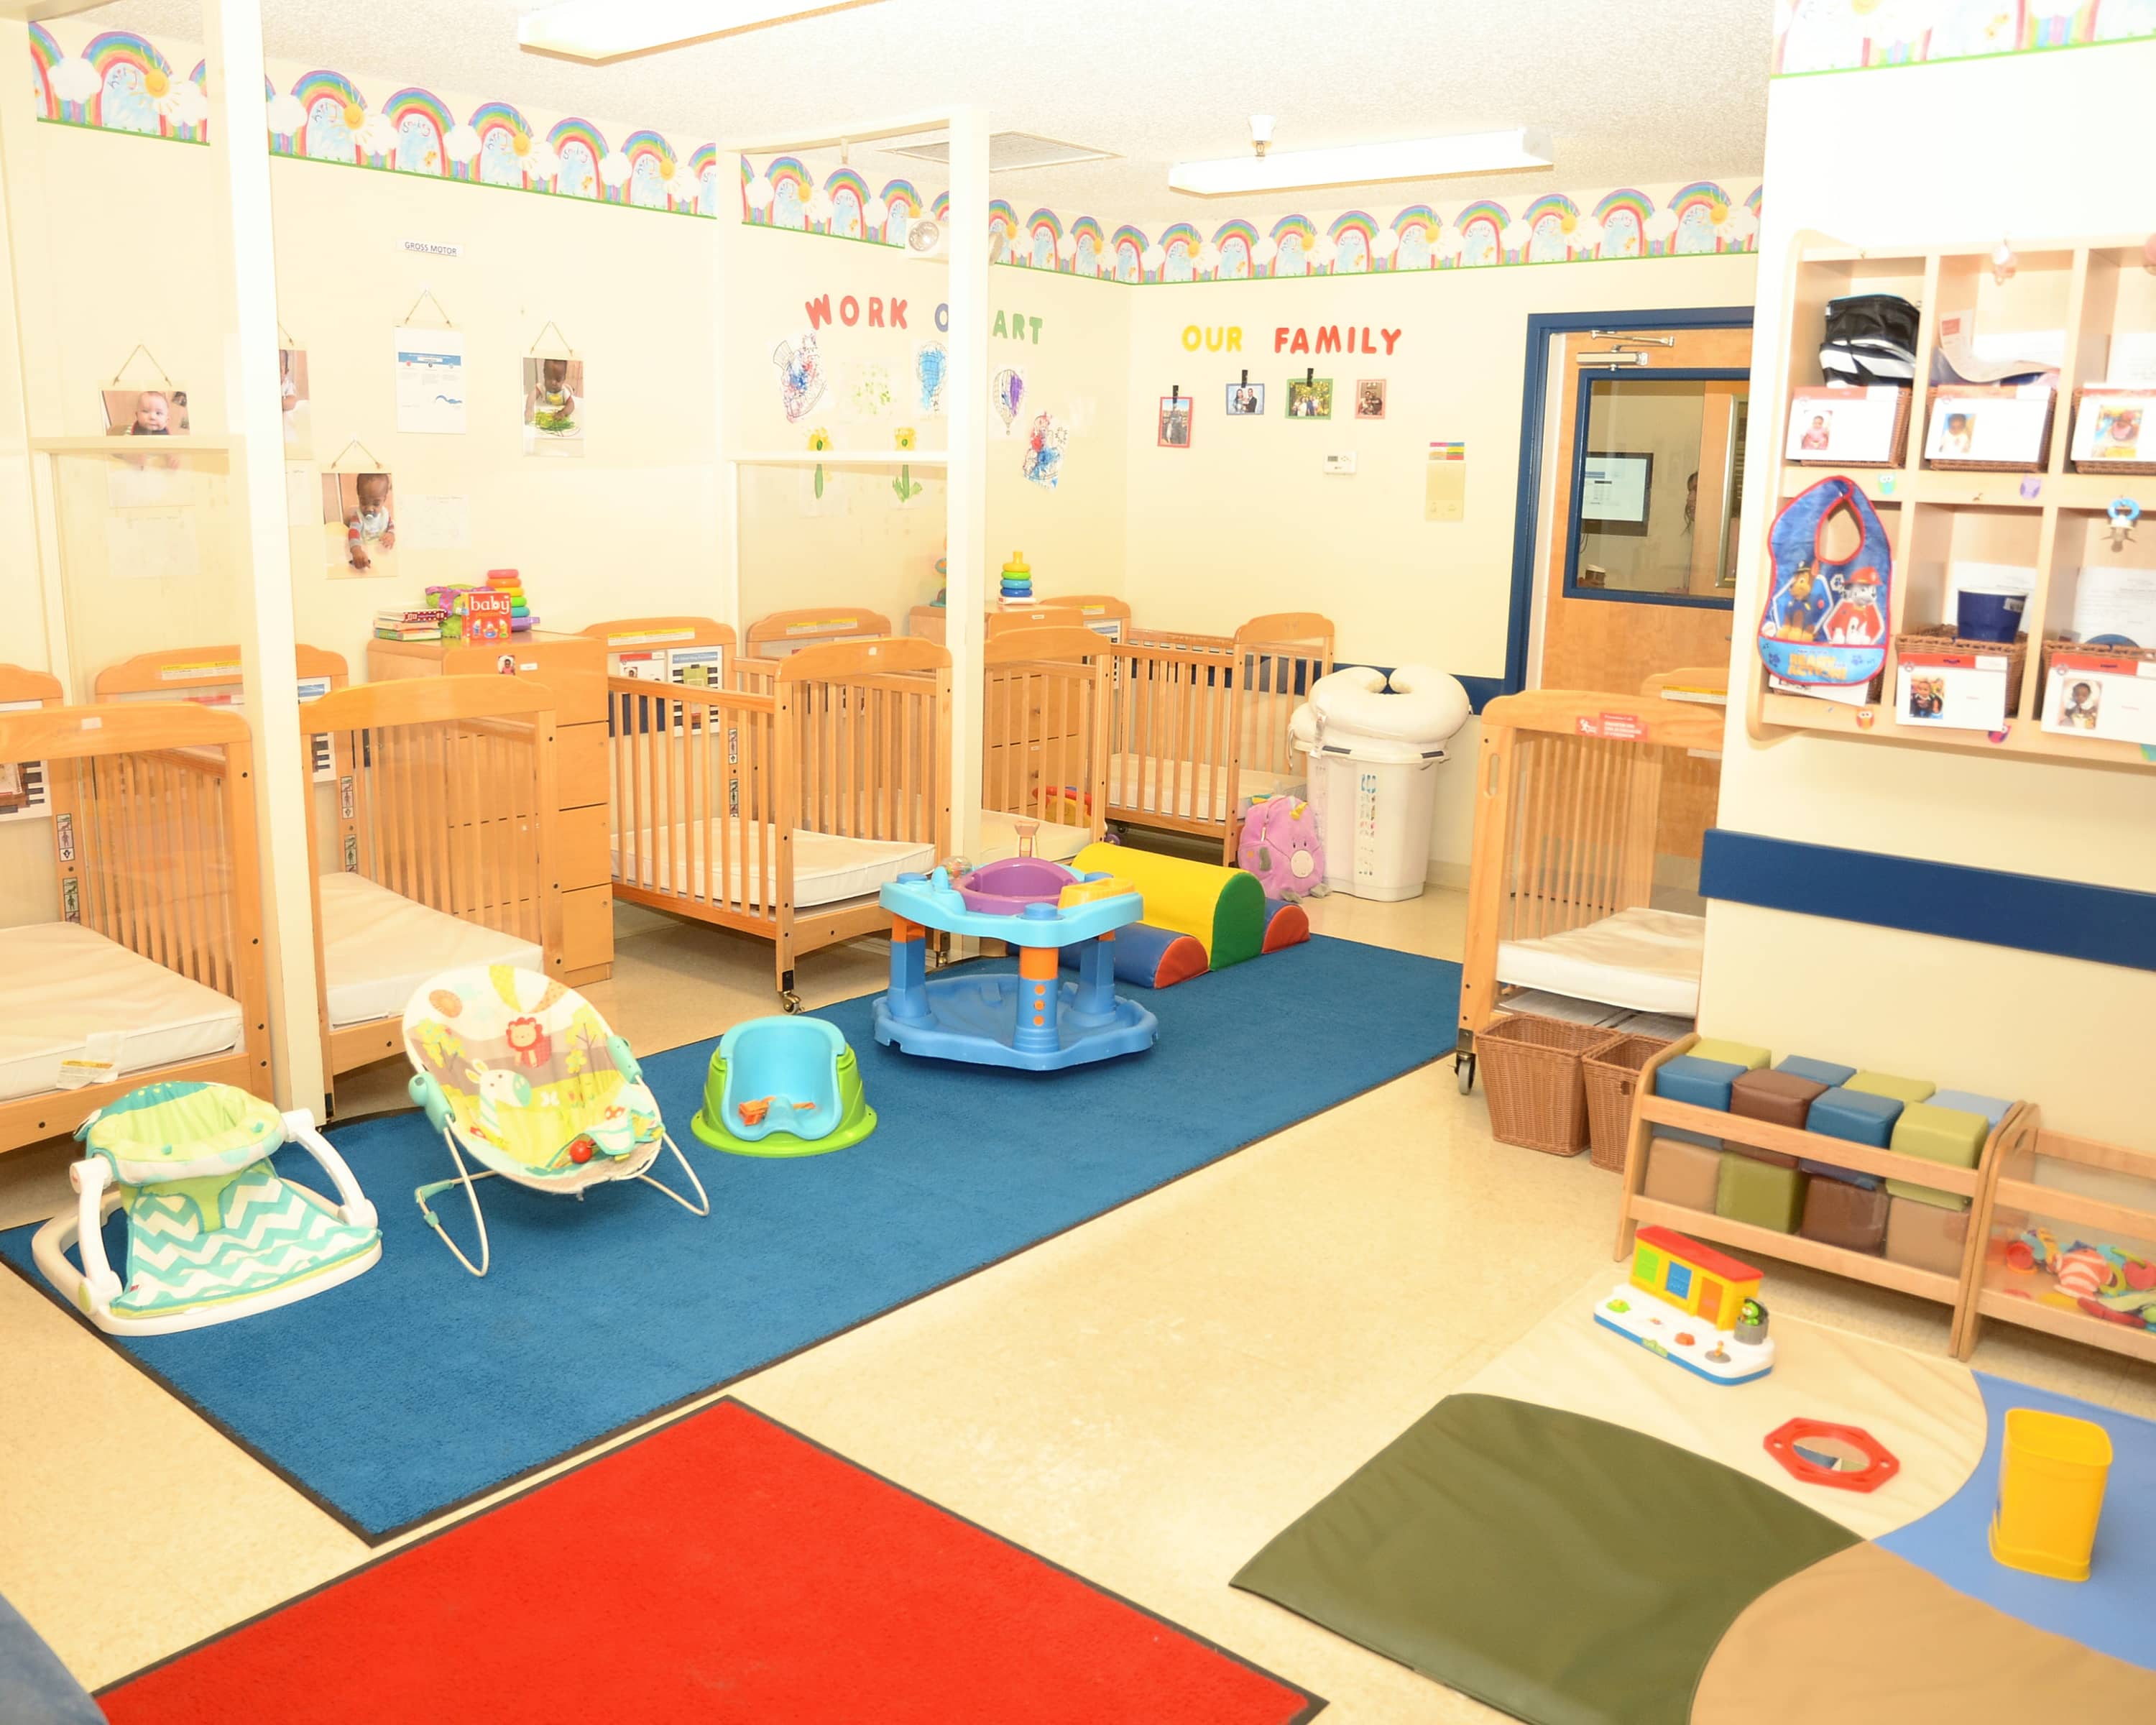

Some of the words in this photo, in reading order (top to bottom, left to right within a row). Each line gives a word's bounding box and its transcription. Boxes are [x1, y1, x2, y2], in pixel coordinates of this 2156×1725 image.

[404, 242, 429, 252] GROSS
[430, 244, 458, 255] MOTOR
[805, 293, 908, 331] WORK
[992, 310, 1044, 345] ART
[1181, 325, 1243, 352] OUR
[1274, 325, 1401, 356] FAMILY
[470, 595, 510, 615] baby
